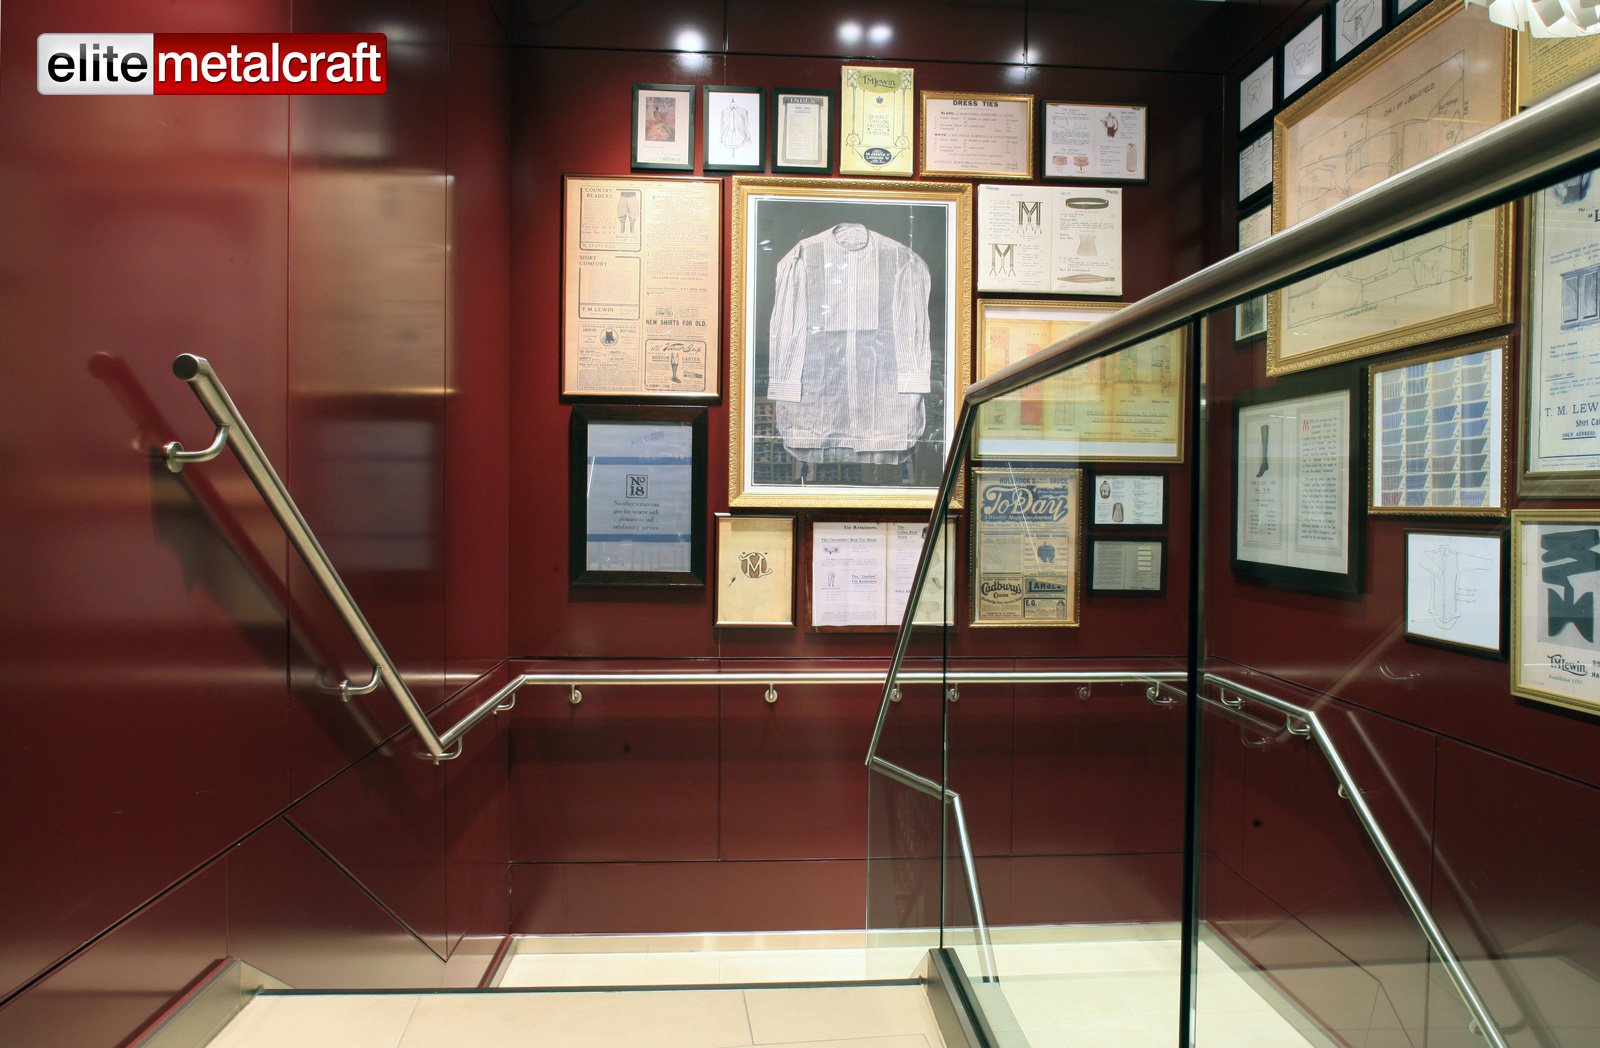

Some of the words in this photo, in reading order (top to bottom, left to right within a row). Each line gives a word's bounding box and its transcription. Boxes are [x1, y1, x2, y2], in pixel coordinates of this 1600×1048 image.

[1544, 407, 1553, 417] T.
[1557, 405, 1568, 415] M.
[1575, 418, 1589, 427] Shirt
[630, 485, 645, 496] 18
[981, 581, 1022, 596] Cadbury's
